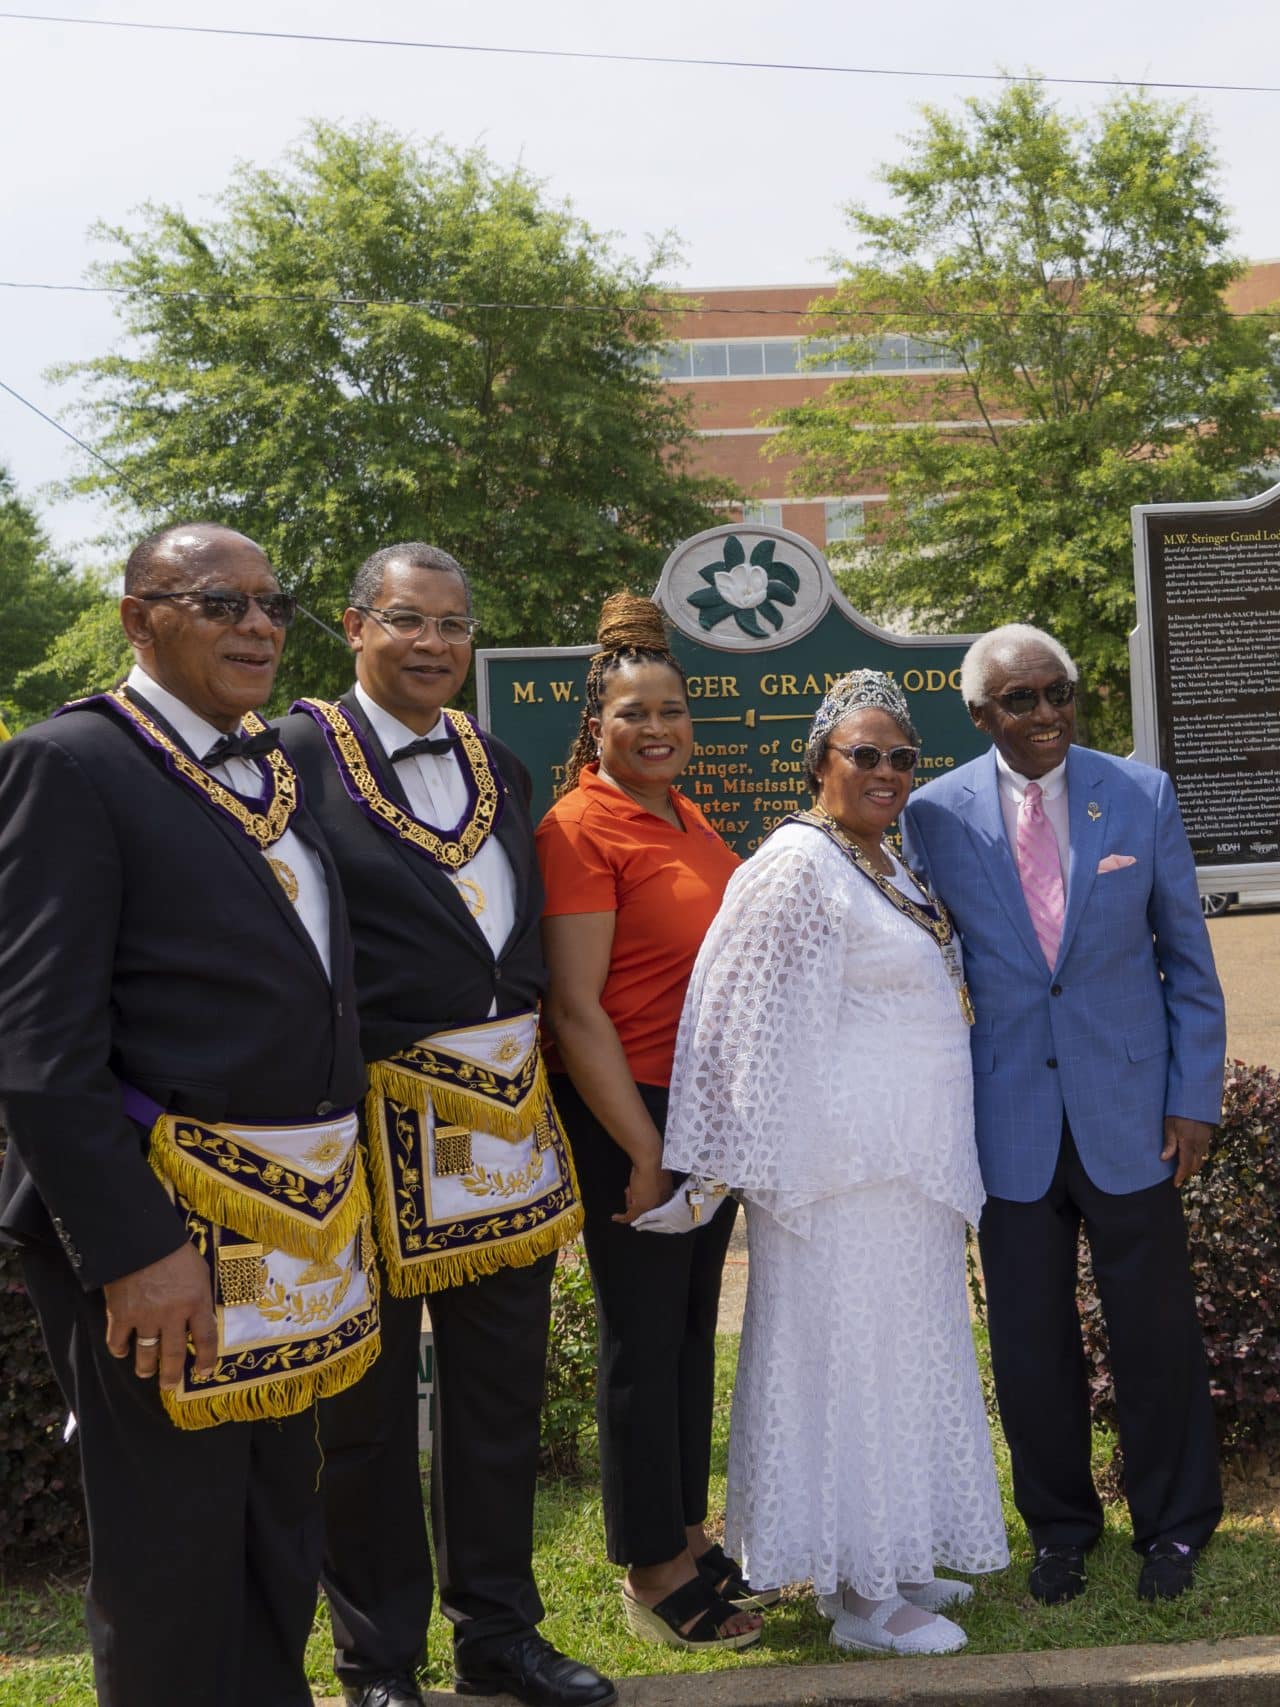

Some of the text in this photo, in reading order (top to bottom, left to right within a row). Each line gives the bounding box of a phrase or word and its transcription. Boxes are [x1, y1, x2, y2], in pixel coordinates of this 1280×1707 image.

[1164, 534, 1190, 545] M.W.
[1192, 533, 1229, 546] Stringer
[1231, 530, 1261, 542] Grand
[512, 682, 543, 703] M.
[550, 681, 579, 702] W.
[760, 671, 850, 695] GRAN
[693, 742, 748, 756] honor
[760, 740, 780, 754] of
[695, 780, 714, 794] in
[723, 777, 812, 795] Mississip
[696, 799, 740, 814] ster
[752, 797, 799, 812] from
[710, 818, 750, 834] May
[1216, 843, 1240, 852] MDAH
